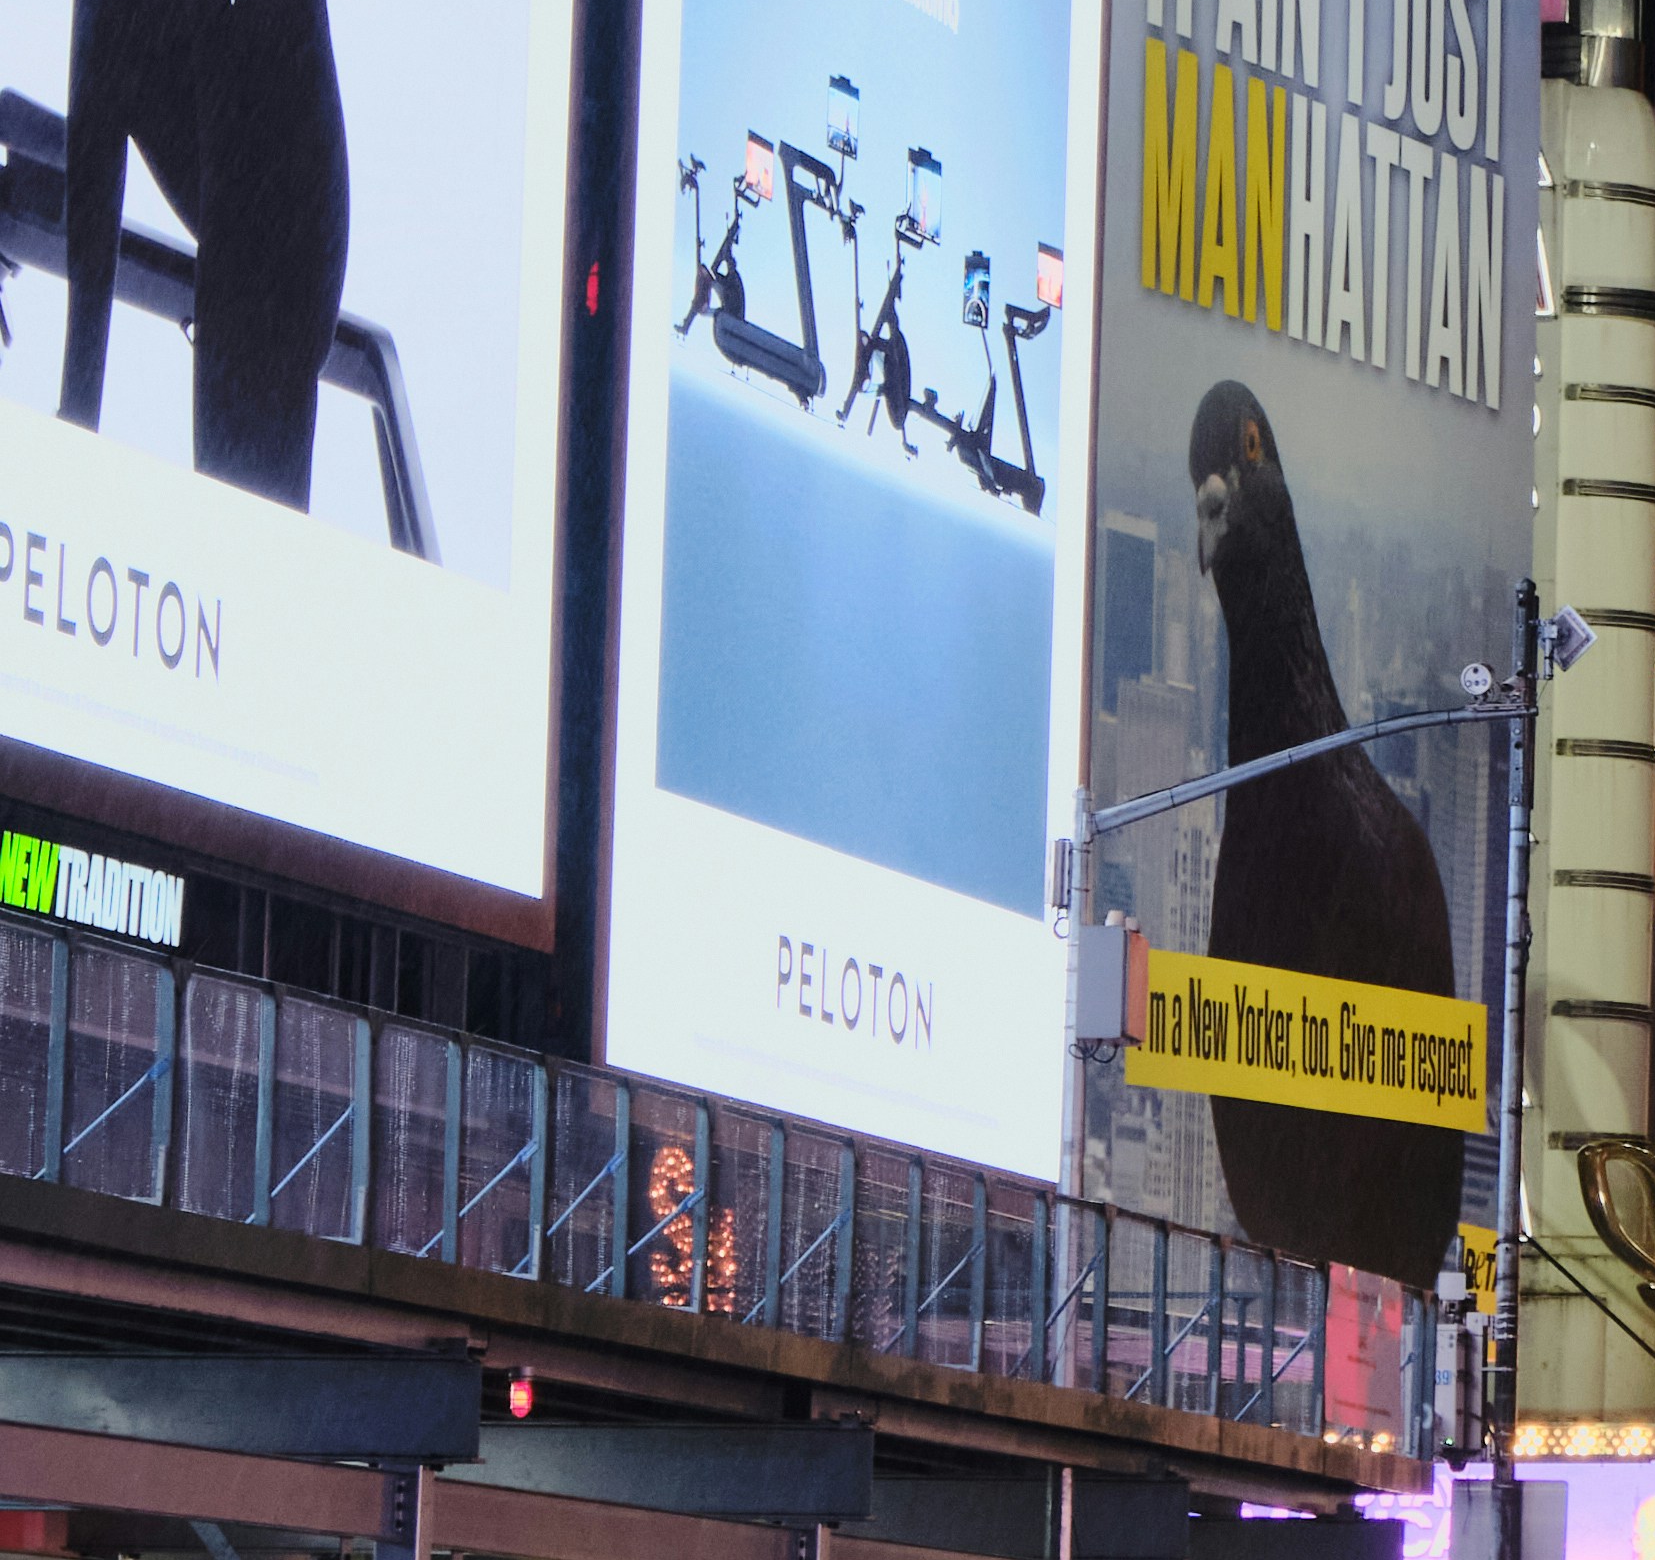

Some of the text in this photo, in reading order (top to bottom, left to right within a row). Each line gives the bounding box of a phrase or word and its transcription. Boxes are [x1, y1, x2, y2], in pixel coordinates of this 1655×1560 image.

[1141, 36, 1504, 412] MANHATTAN
[775, 933, 935, 1052] PELOTON
[1171, 993, 1183, 1057] a
[1188, 976, 1230, 1063] New
[1234, 984, 1297, 1078] Yorker,
[1301, 996, 1335, 1080] too.
[1339, 1000, 1376, 1086] Give
[1380, 1027, 1406, 1090] me
[1410, 1024, 1478, 1107] respect.
